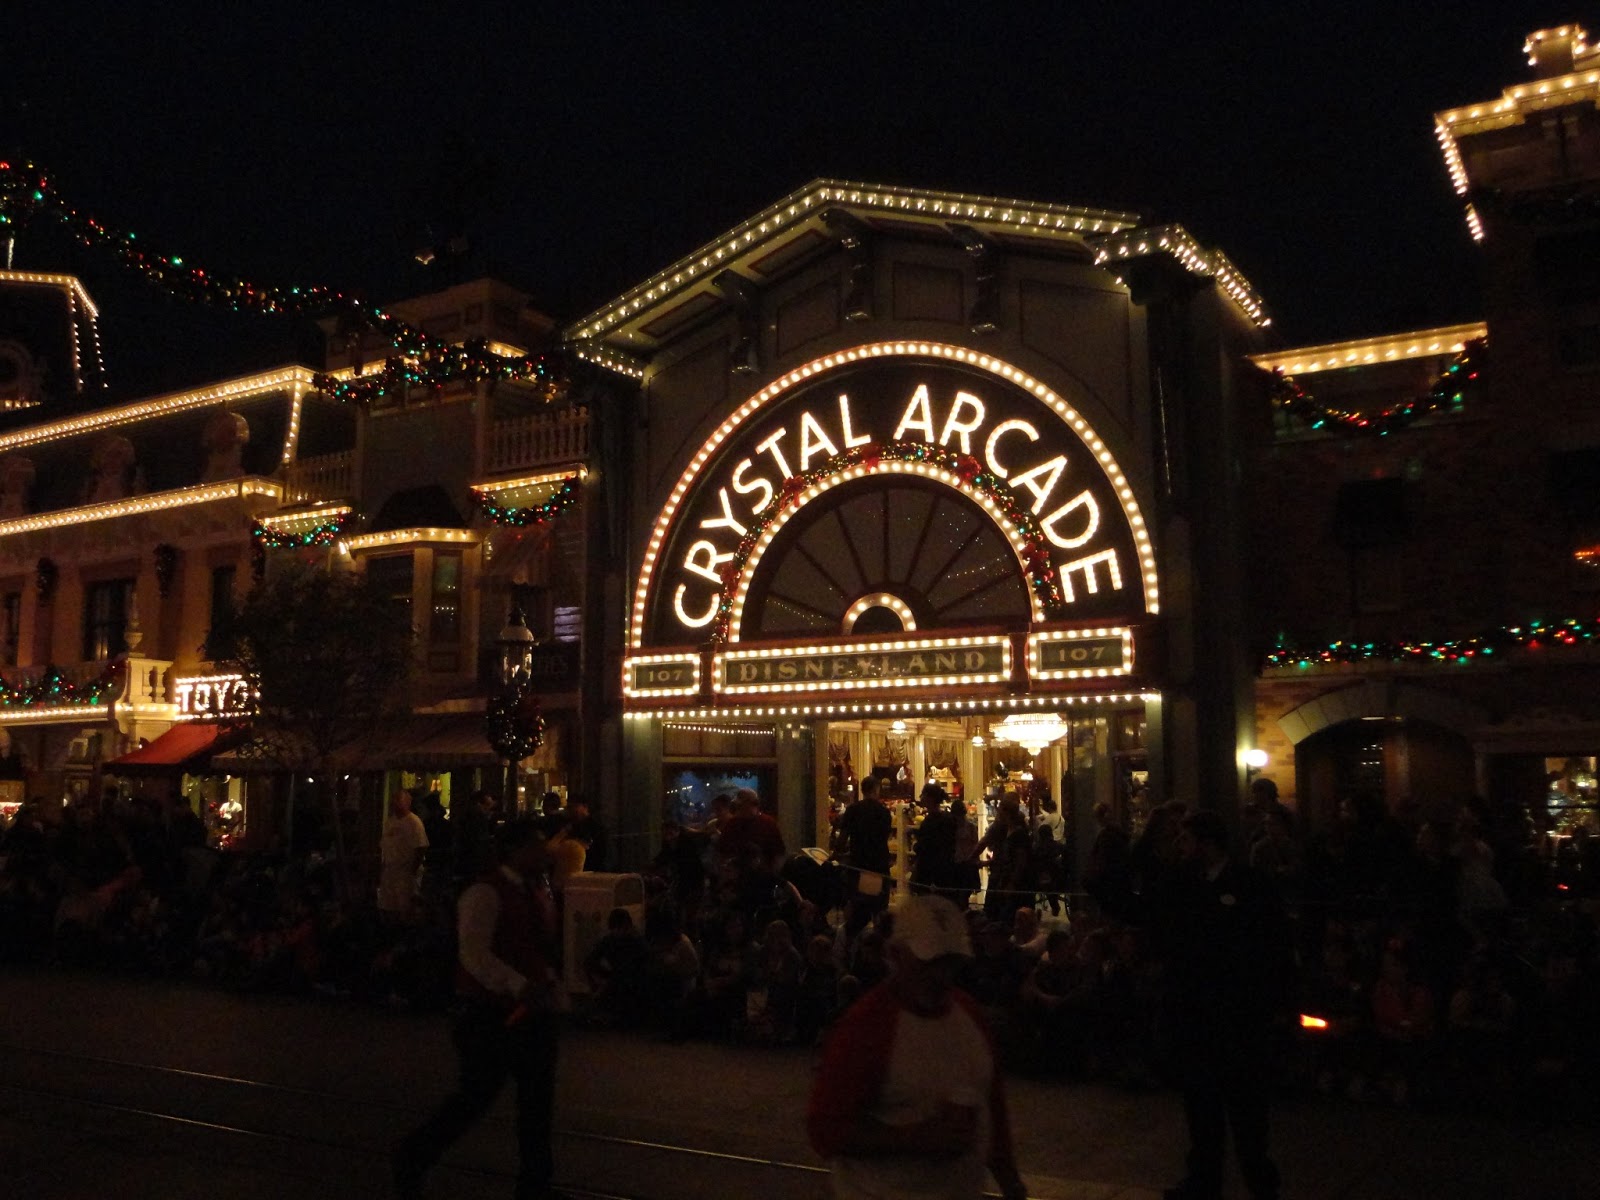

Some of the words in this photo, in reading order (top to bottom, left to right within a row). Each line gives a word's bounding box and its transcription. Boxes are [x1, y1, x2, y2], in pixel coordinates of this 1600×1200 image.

[674, 395, 871, 628] CRYSTAL
[893, 384, 1122, 603] ARCADE
[1059, 646, 1105, 662] 107
[649, 669, 683, 682] 107
[739, 651, 985, 682] DISNEYLAND
